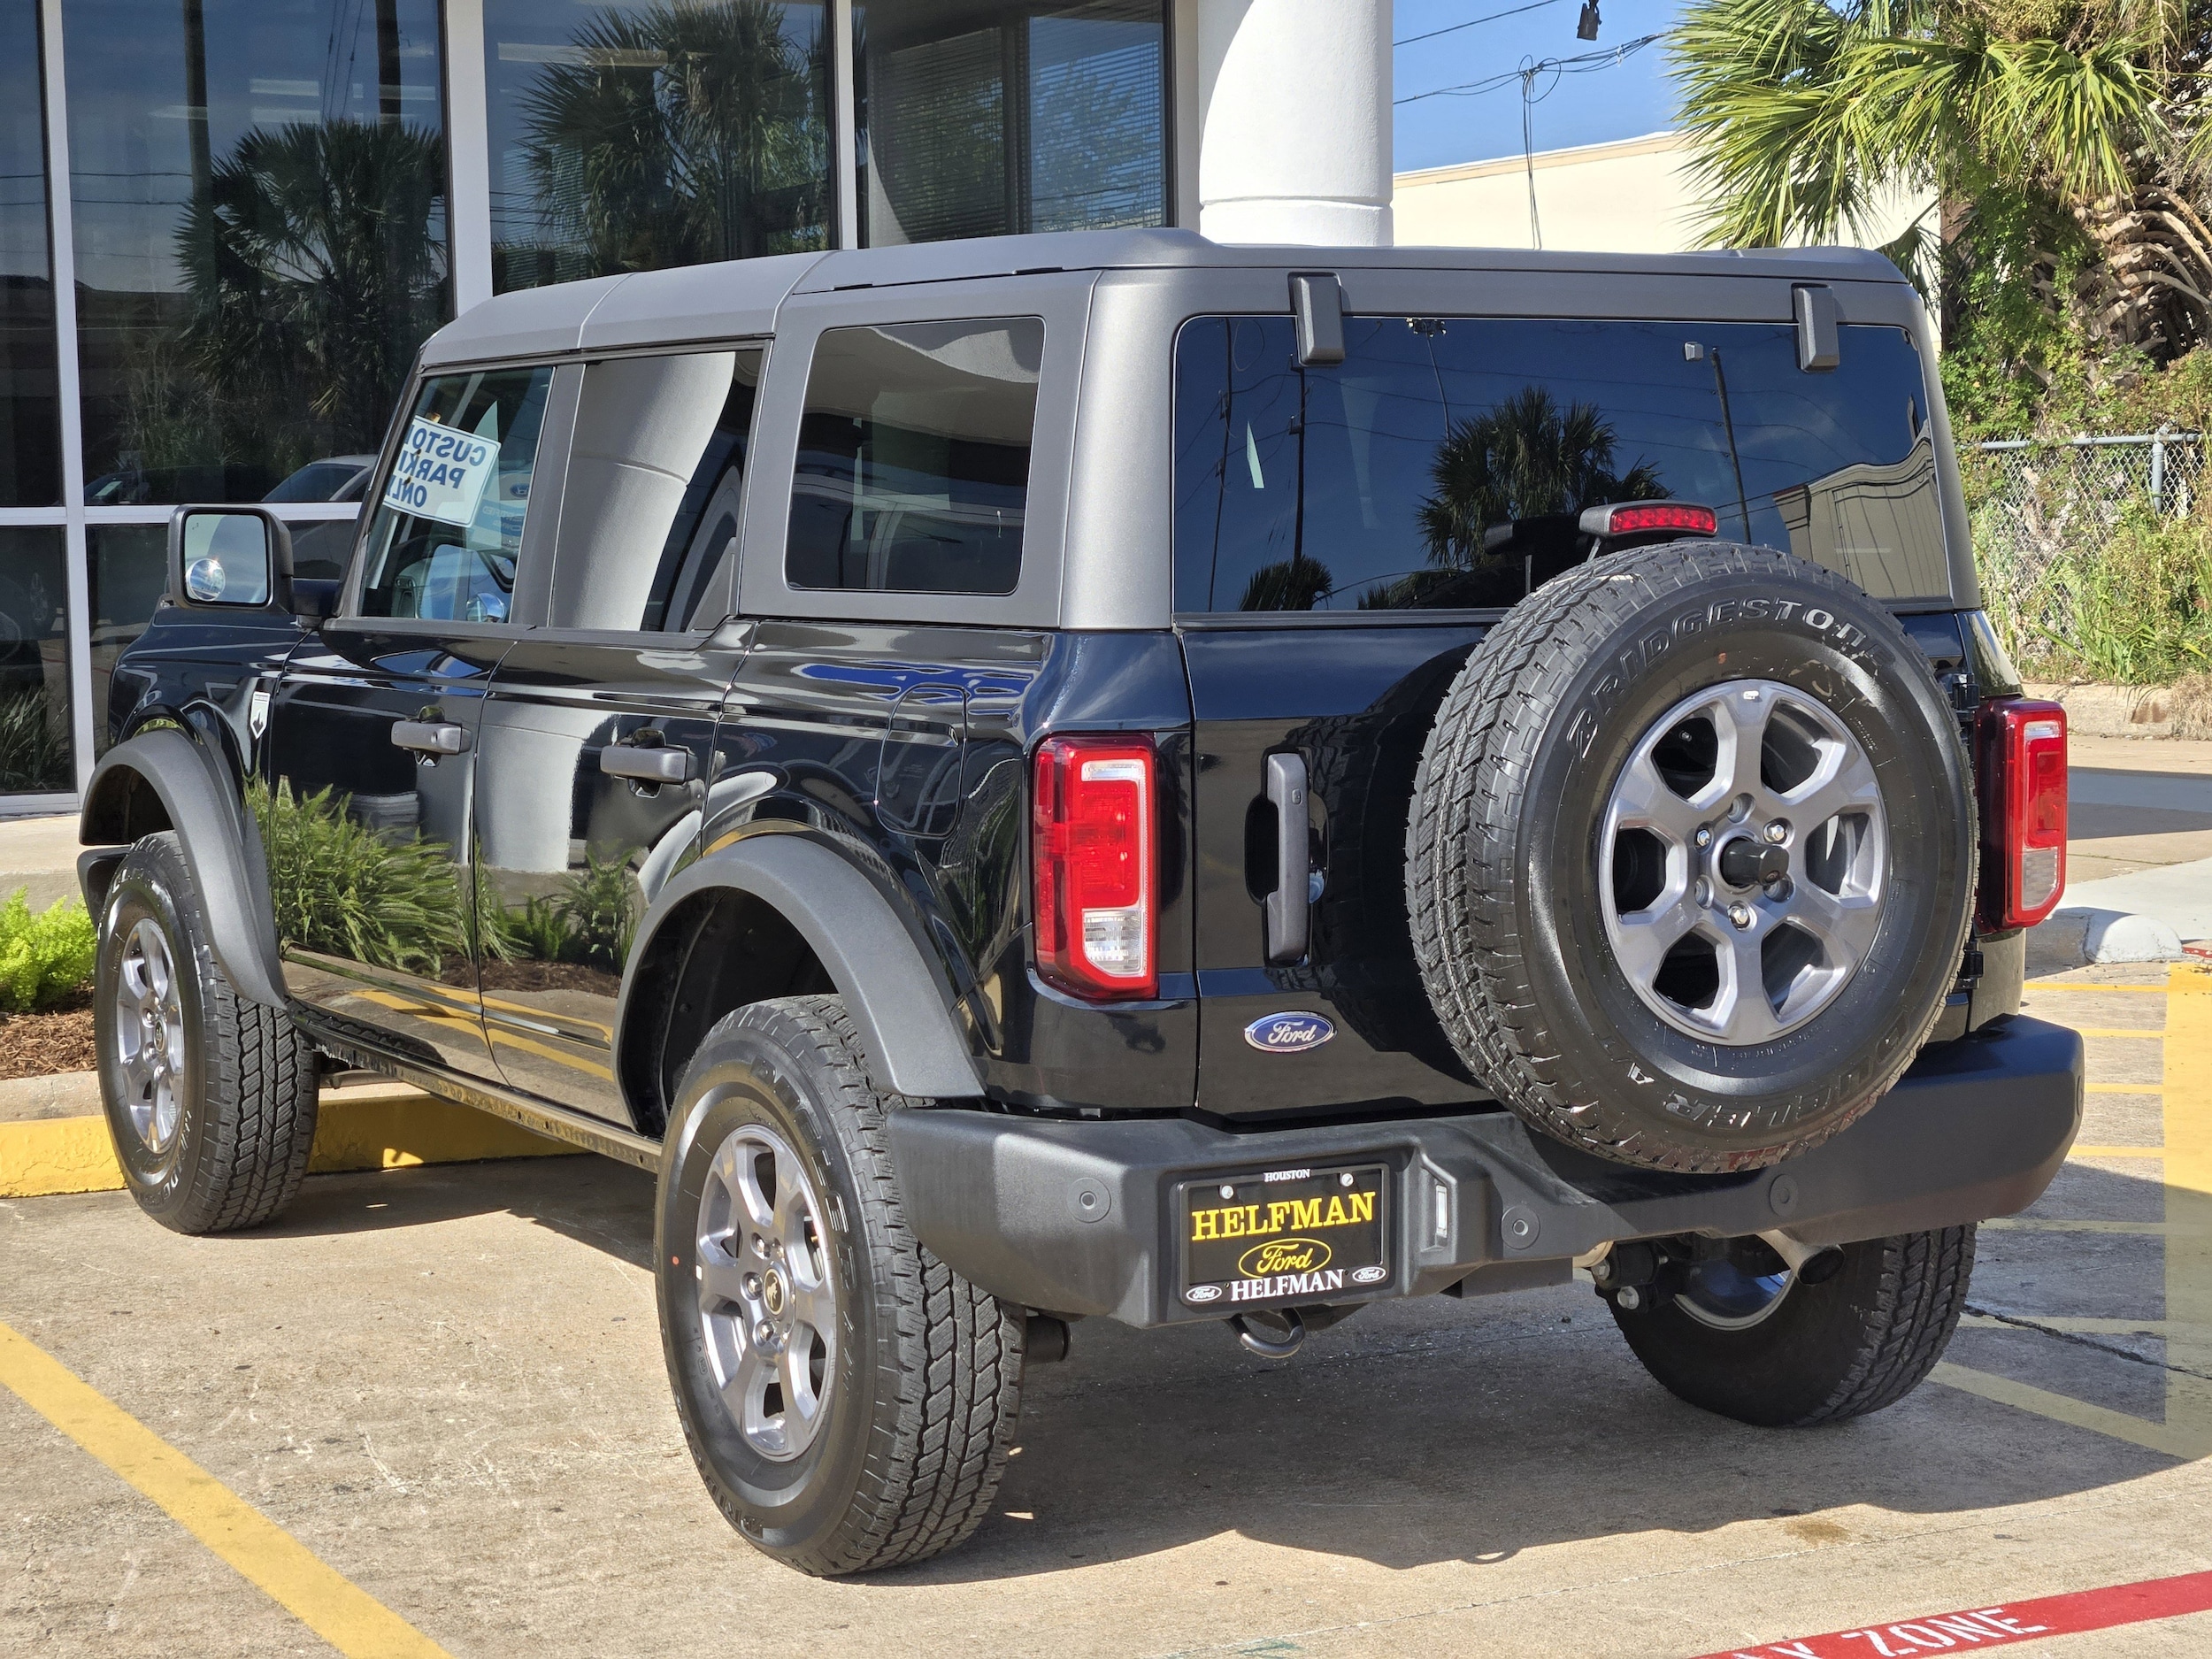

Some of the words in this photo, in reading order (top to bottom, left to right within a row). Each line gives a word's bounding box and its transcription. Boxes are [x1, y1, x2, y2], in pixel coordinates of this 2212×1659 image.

[1268, 1019, 1316, 1045] Ford
[1263, 1168, 1310, 1182] HOUSTON
[1191, 1191, 1376, 1241] HELFMAN
[1256, 1242, 1314, 1274] Ford
[1230, 1268, 1344, 1302] HELFMAN
[1840, 1608, 2048, 1657] ZONE
